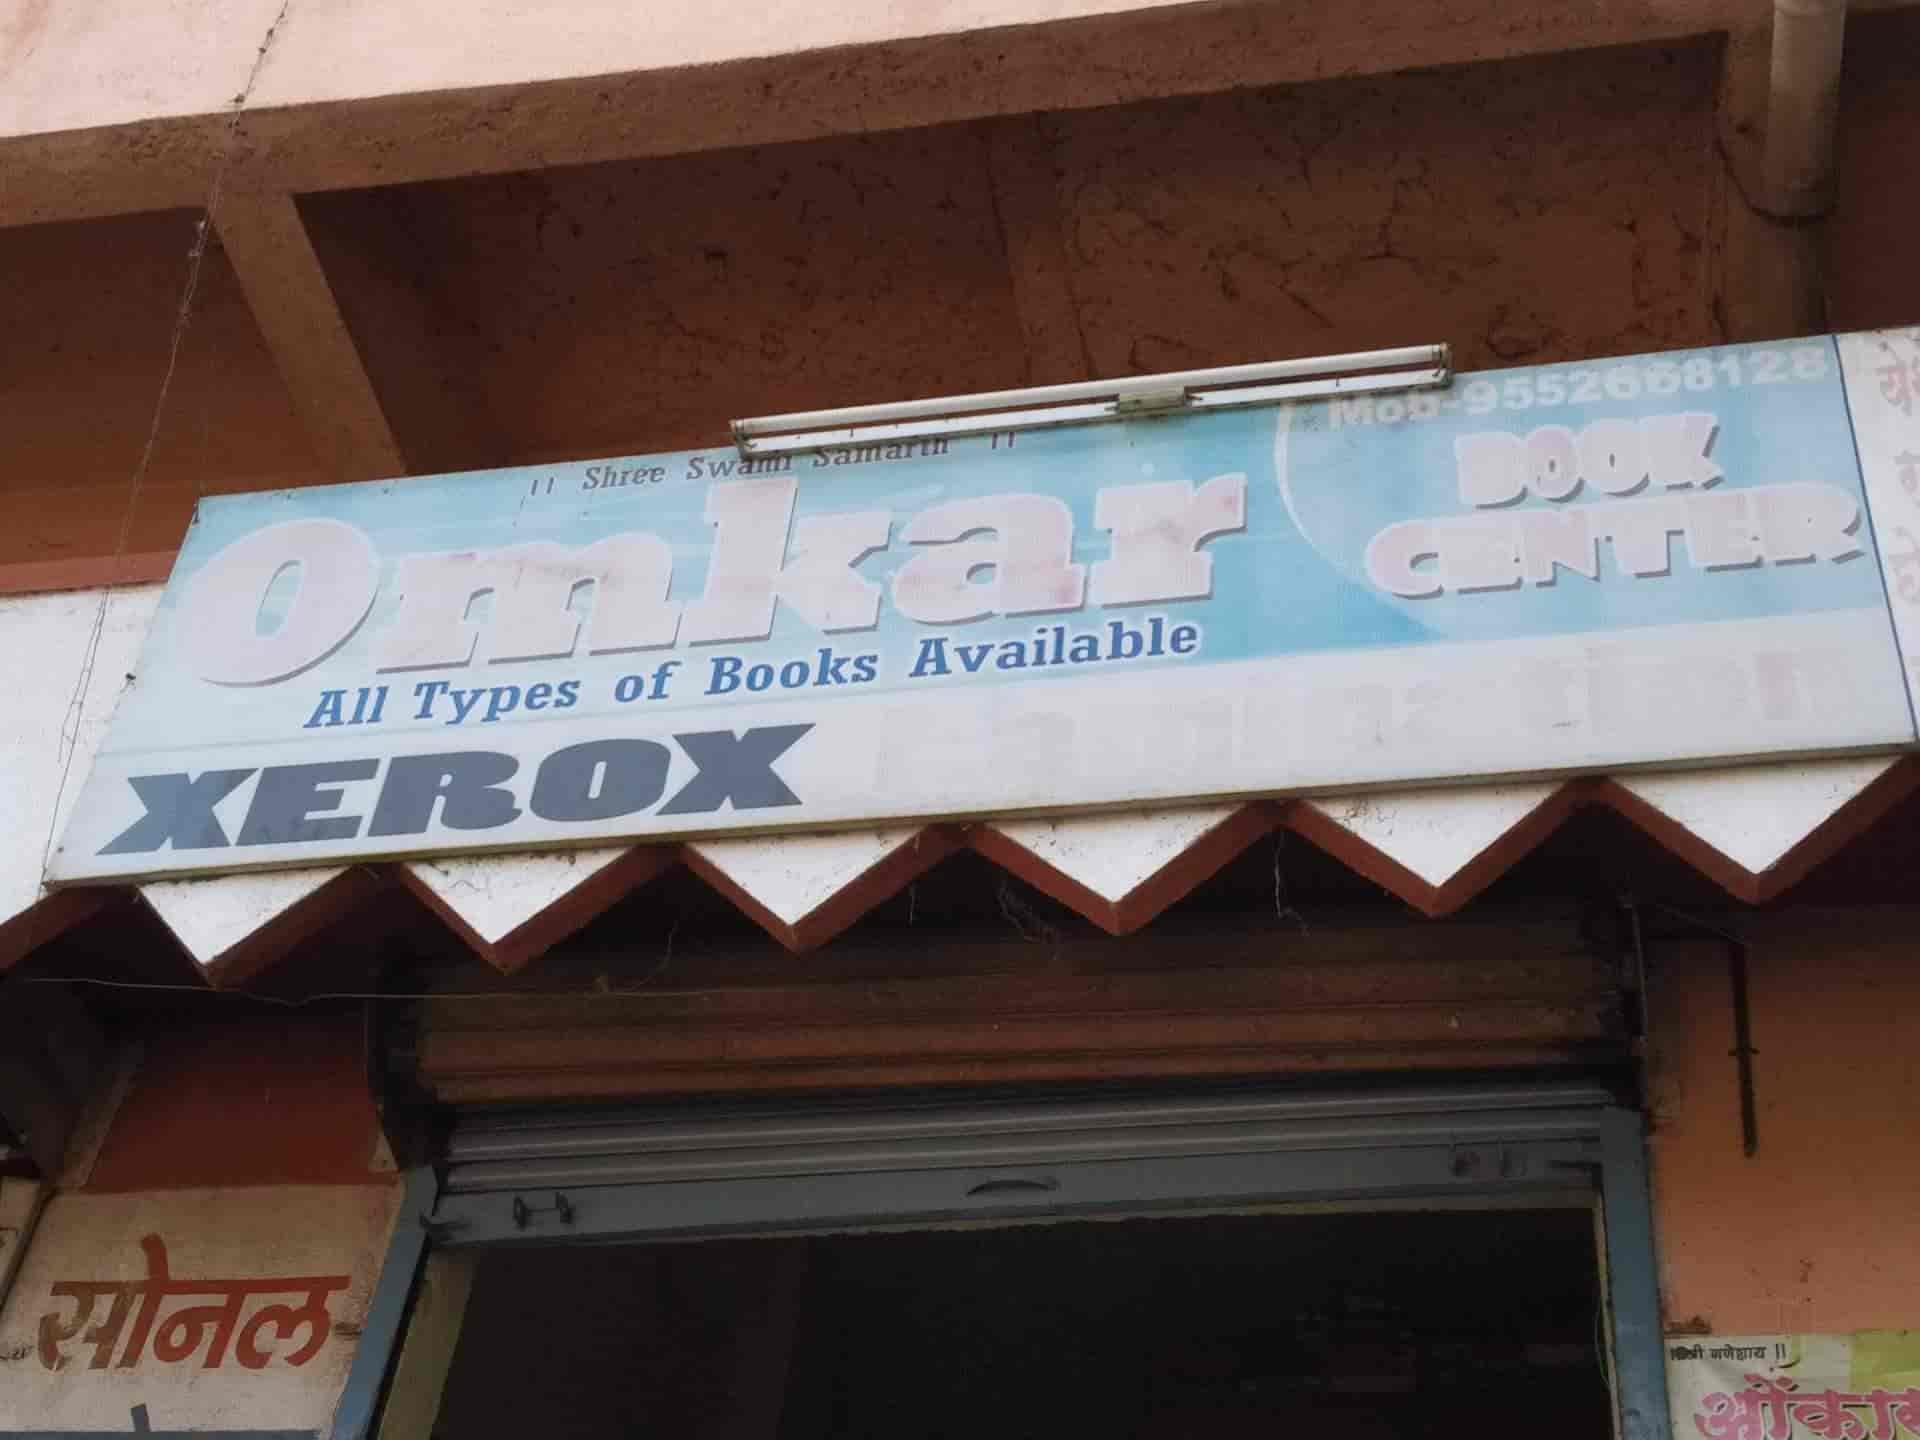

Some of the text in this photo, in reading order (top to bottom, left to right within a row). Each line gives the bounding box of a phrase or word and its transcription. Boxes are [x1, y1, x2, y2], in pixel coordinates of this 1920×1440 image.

[582, 466, 665, 490] Shree
[1454, 411, 1723, 509] BOOK
[178, 474, 1247, 688] Omkar
[1366, 482, 1866, 599] CENTER
[303, 616, 1198, 728] All Types of Books Available
[95, 722, 816, 856] XEROX
[37, 1233, 353, 1372] सोनल
